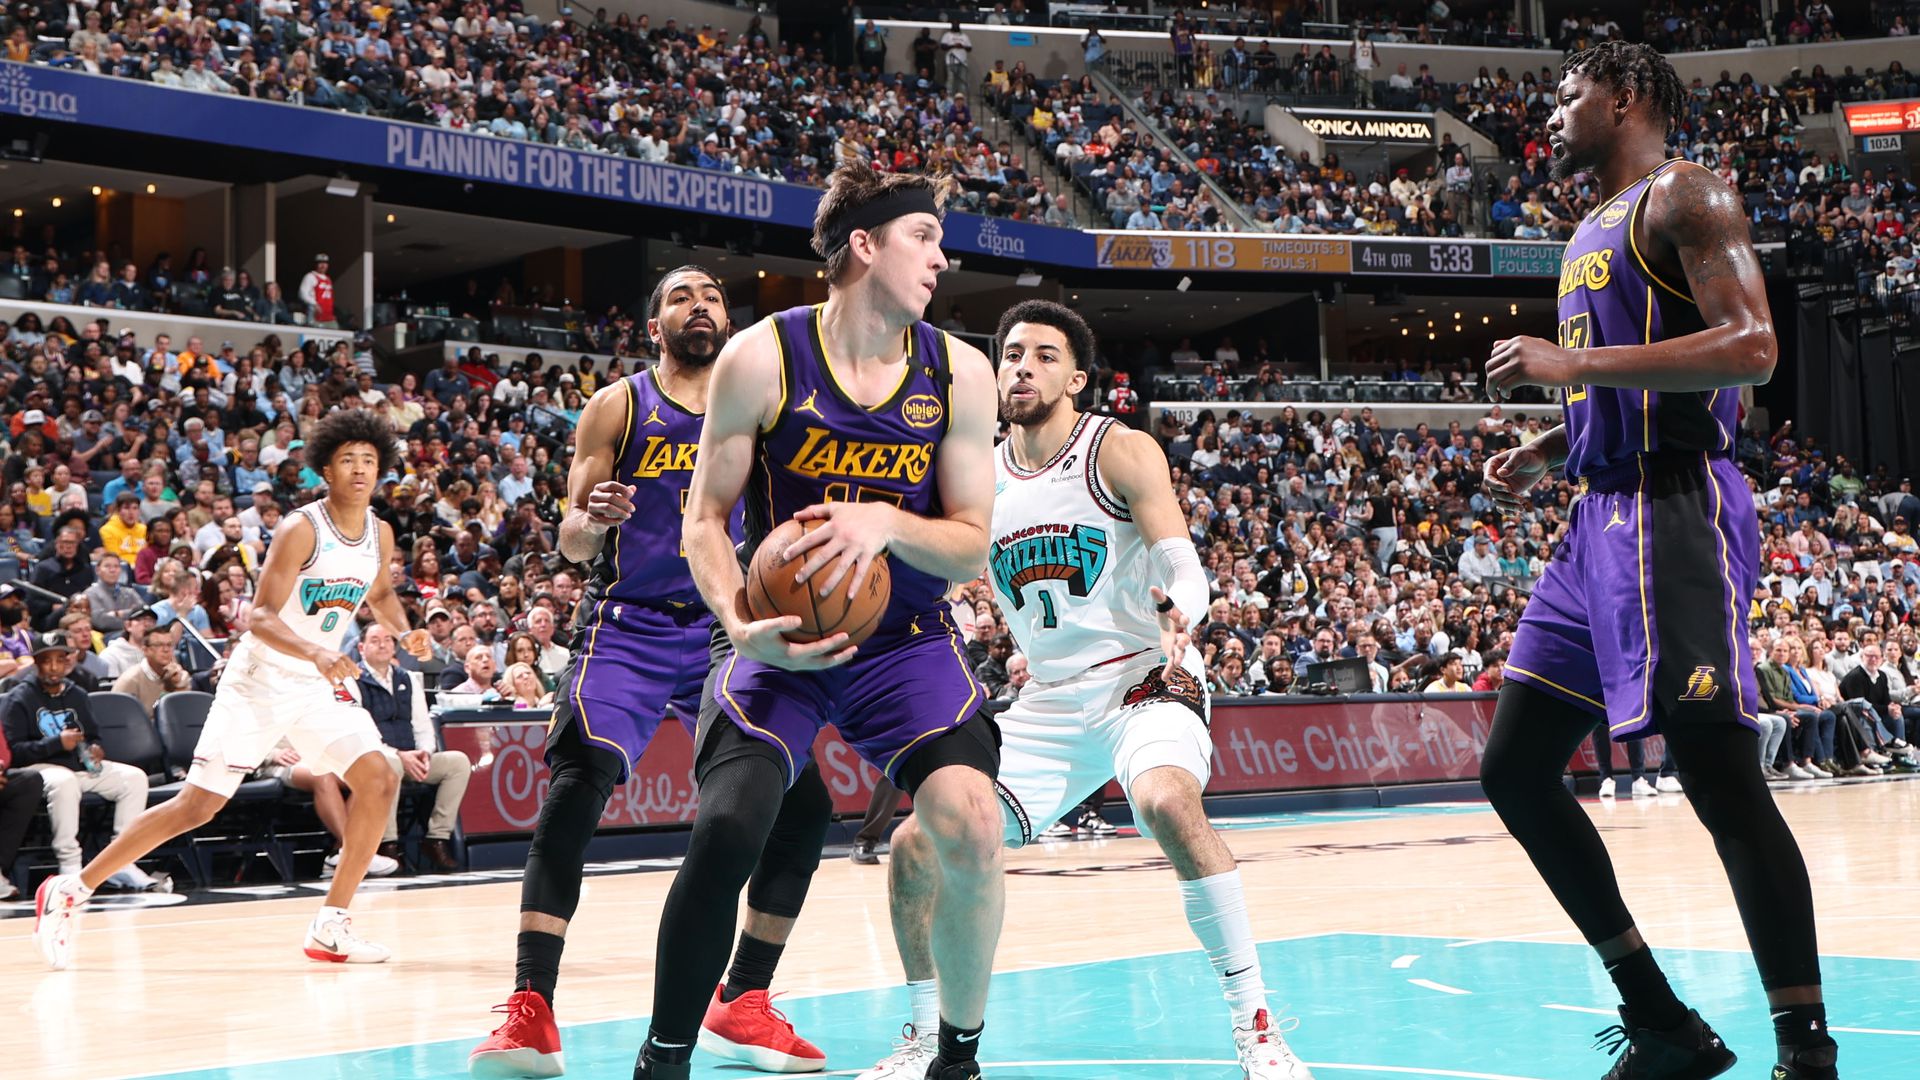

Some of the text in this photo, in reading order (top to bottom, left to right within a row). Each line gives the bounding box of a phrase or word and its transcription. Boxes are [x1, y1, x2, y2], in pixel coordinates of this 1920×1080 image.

[0, 84, 78, 117] cigna
[1303, 119, 1431, 138] KONICA MINOLTA
[1870, 138, 1898, 151] 103A
[387, 125, 773, 219] PLANNING FOR THE UNEXPECTED
[977, 230, 1025, 256] cigna
[1097, 236, 1174, 268] LAKERS
[1185, 239, 1236, 269] 118
[1362, 246, 1412, 269] 4TH QTR
[1429, 244, 1473, 273] 5:33
[1559, 248, 1614, 298] AKERS
[905, 402, 940, 418] bibigo
[632, 436, 700, 478] LAK
[784, 426, 935, 484] LAKERS
[999, 523, 1070, 546] VANCOUVER
[989, 524, 1108, 611] GRIZZLIES
[300, 578, 369, 616] GRIZZLI
[1038, 590, 1057, 629] 1
[320, 611, 339, 632] 0
[1230, 727, 1298, 775] the
